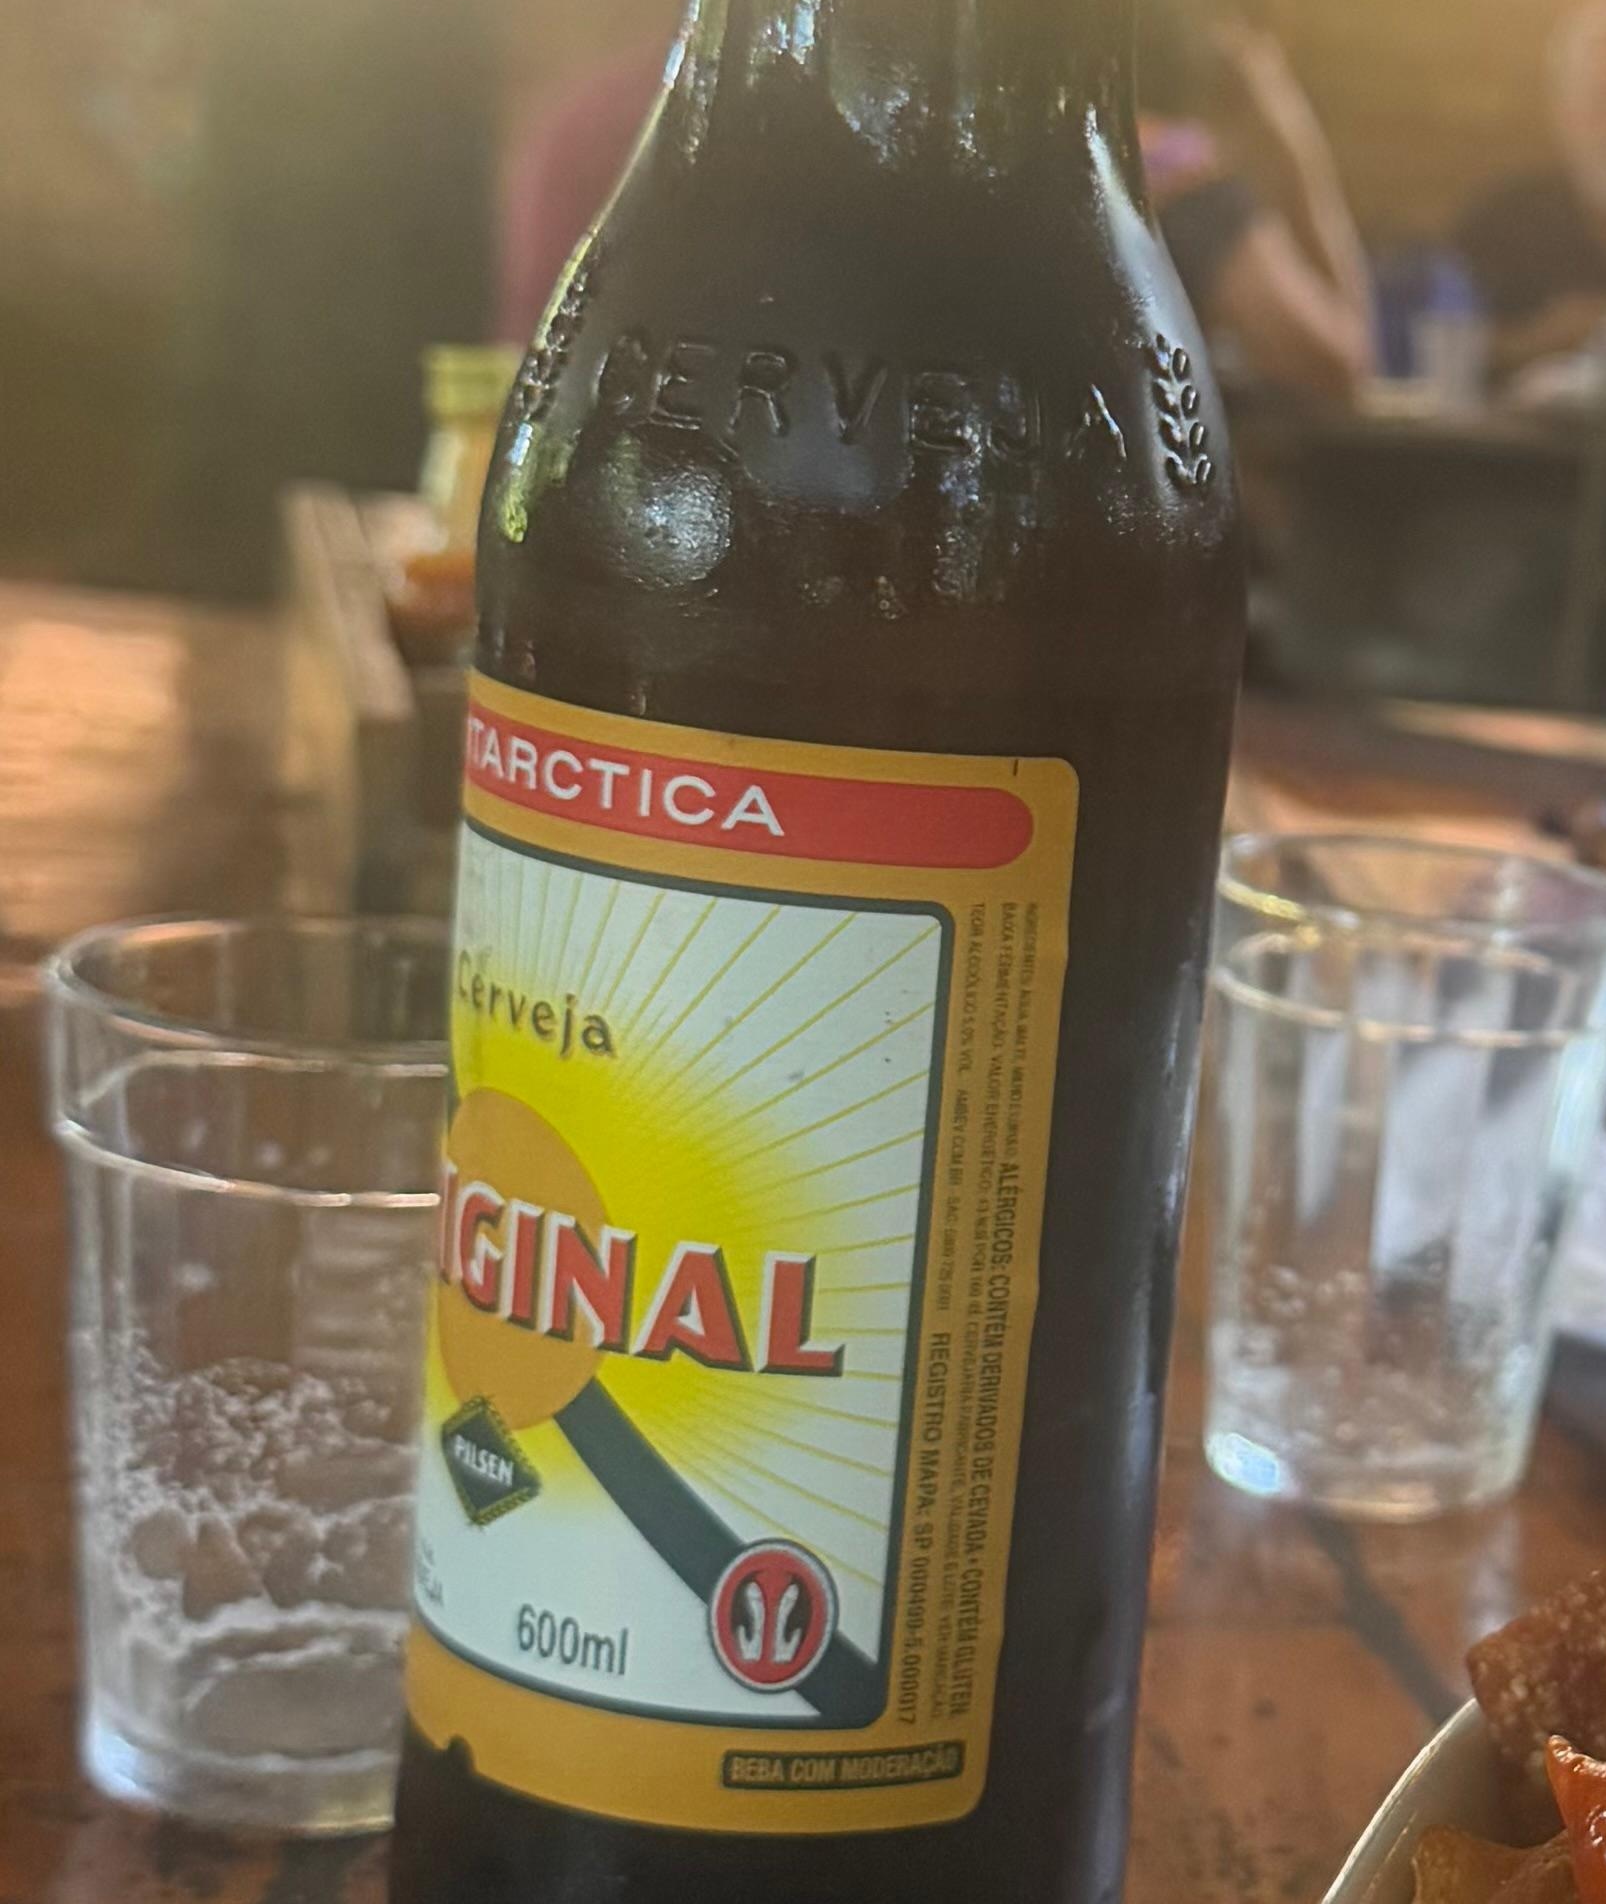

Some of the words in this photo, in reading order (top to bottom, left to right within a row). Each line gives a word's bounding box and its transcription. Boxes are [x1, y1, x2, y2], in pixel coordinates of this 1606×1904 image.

[467, 716, 785, 837] TARCTICA
[458, 948, 616, 1062] Cerveja
[991, 1162, 1024, 1270] ALÉRGICOS:
[983, 1273, 1013, 1348] CONTÉM
[922, 1331, 950, 1442] REGISTRO
[973, 1352, 1001, 1452] DERIVADOS
[453, 1433, 515, 1488] PILSEN
[915, 1448, 939, 1516] MAPA:
[971, 1455, 992, 1480] DE
[913, 1522, 932, 1549] SP
[964, 1484, 990, 1553] CEVADA
[517, 1602, 629, 1676] 600ml
[956, 1567, 986, 1641] CONTÉM
[730, 1756, 785, 1783] BEBA
[790, 1756, 837, 1782] COM
